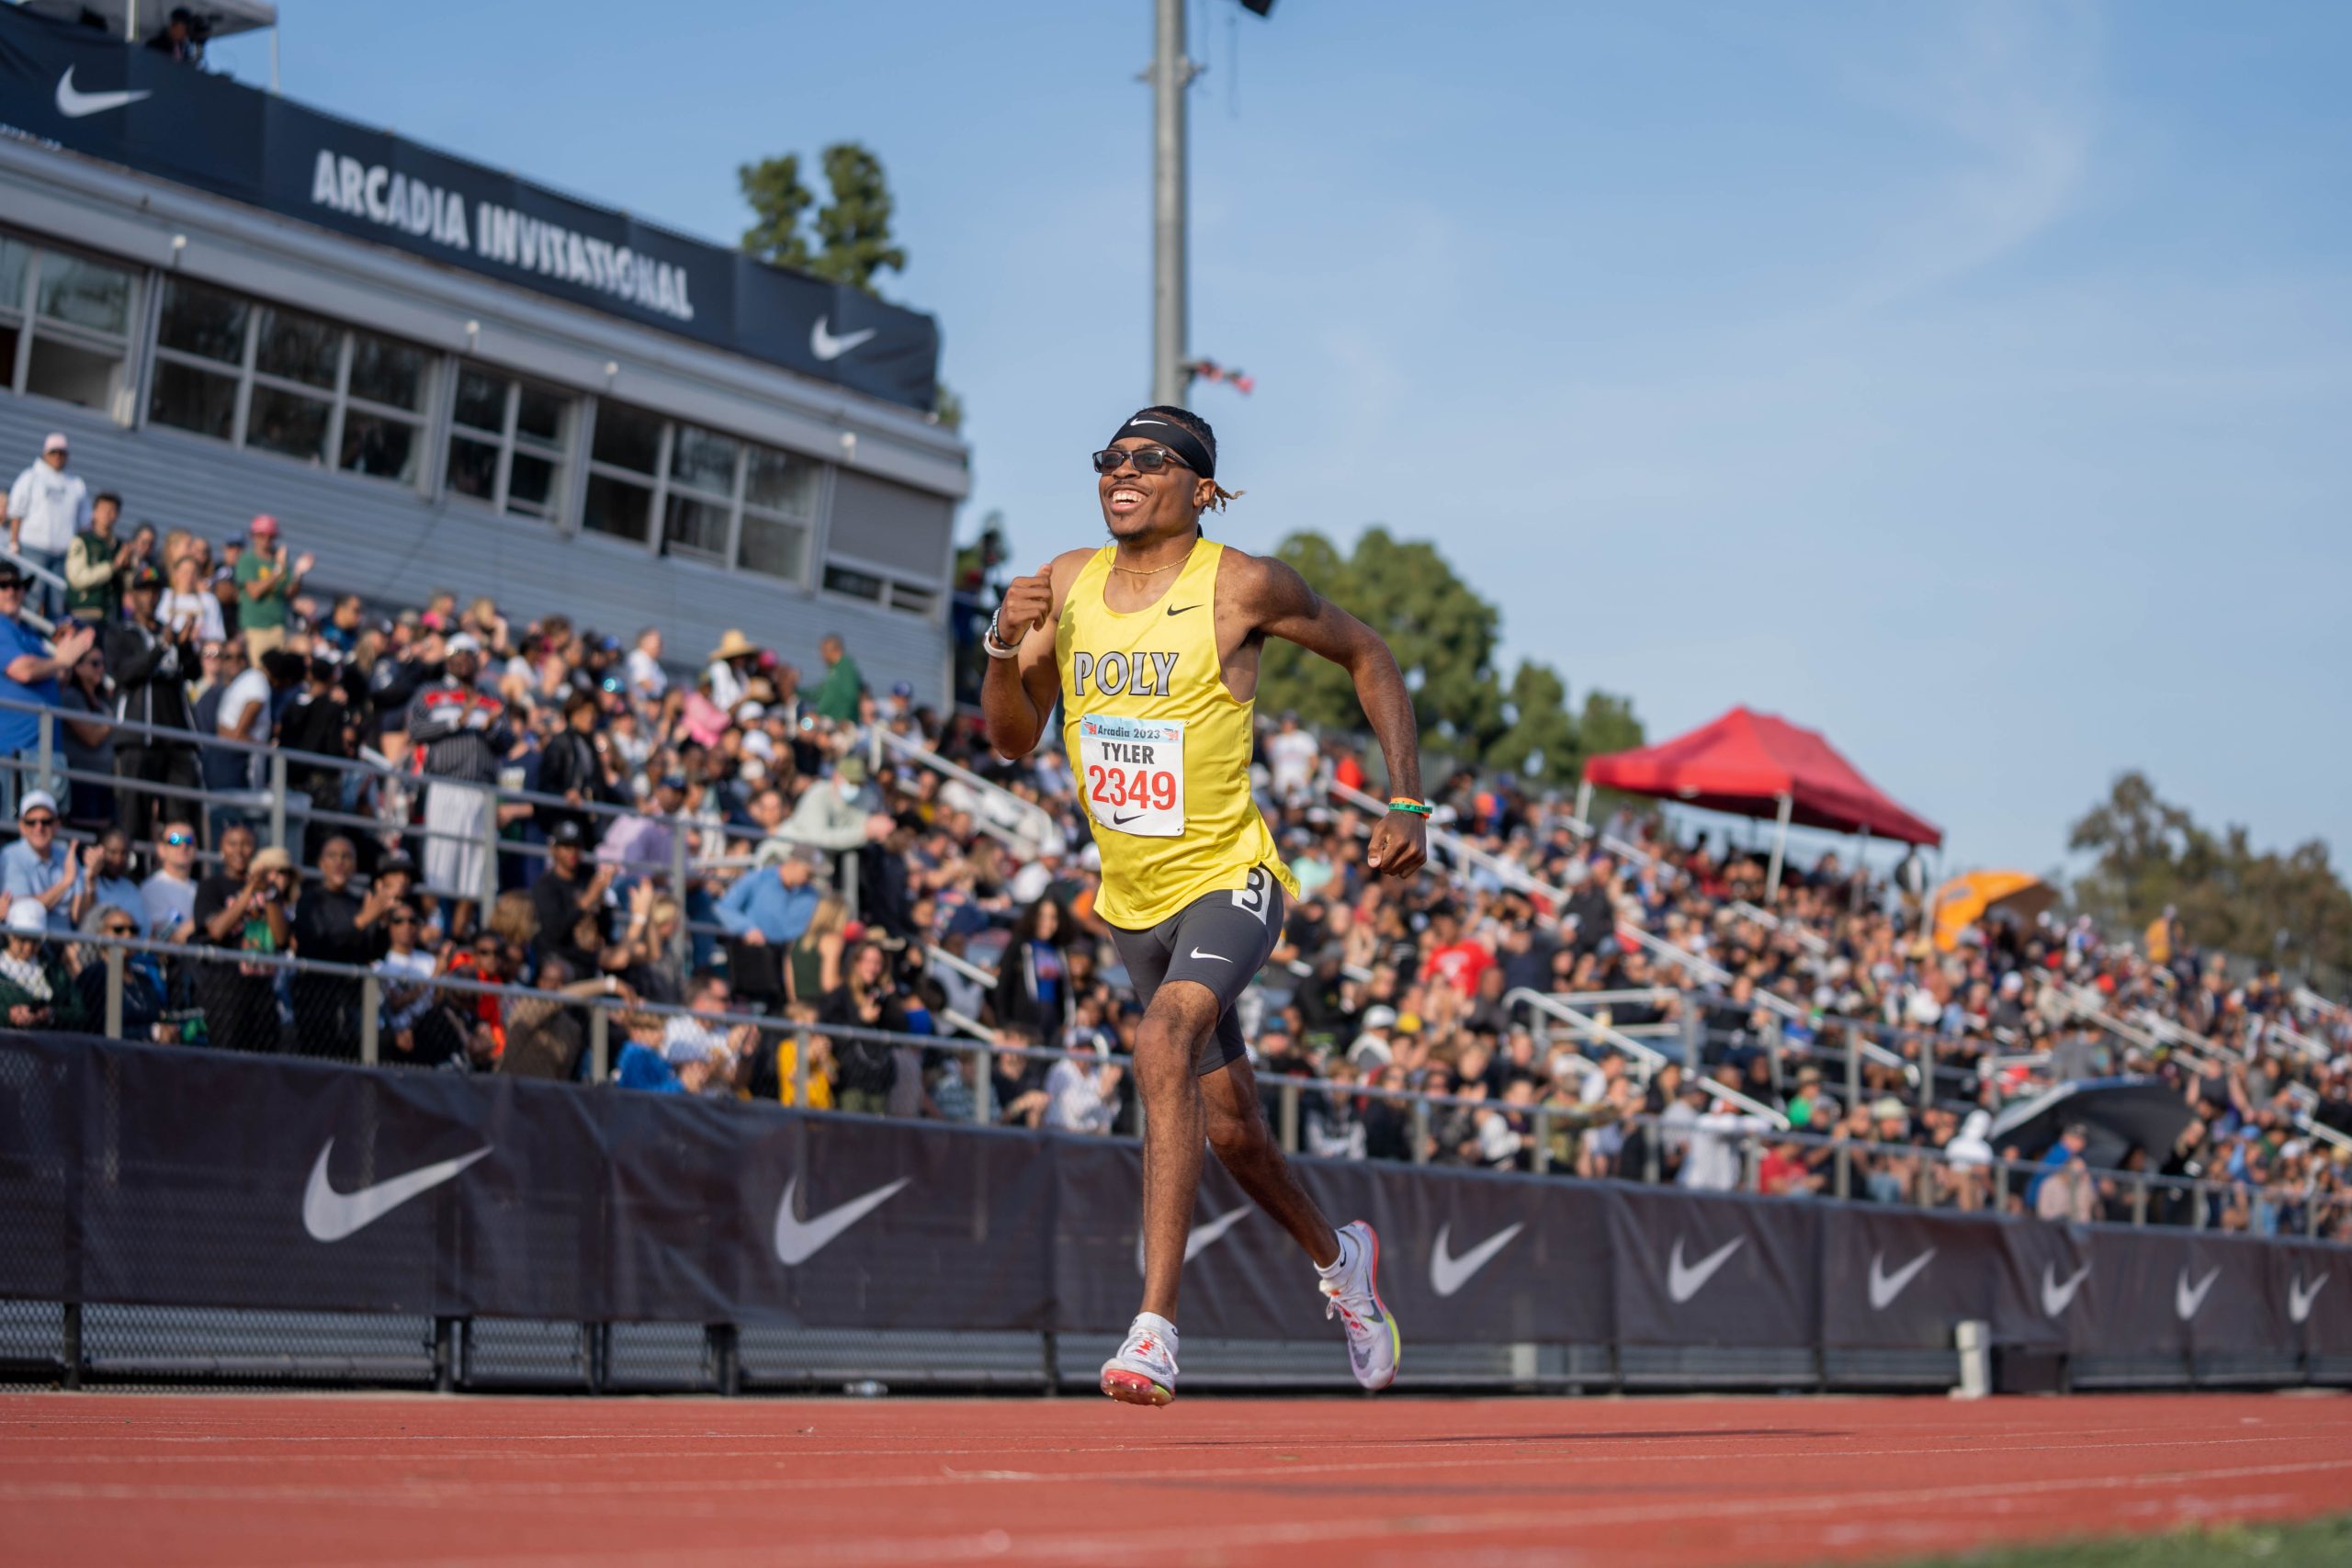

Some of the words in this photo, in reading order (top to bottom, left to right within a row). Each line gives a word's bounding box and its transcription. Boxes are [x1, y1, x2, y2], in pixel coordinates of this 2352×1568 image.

[311, 150, 469, 251] ARCADIA
[477, 201, 695, 321] INVITATIONAL
[1074, 651, 1180, 696] POLY
[1098, 725, 1130, 738] Arcadia
[1134, 728, 1160, 739] 2023
[1102, 742, 1155, 764] TYLER
[1089, 765, 1177, 810] 2349
